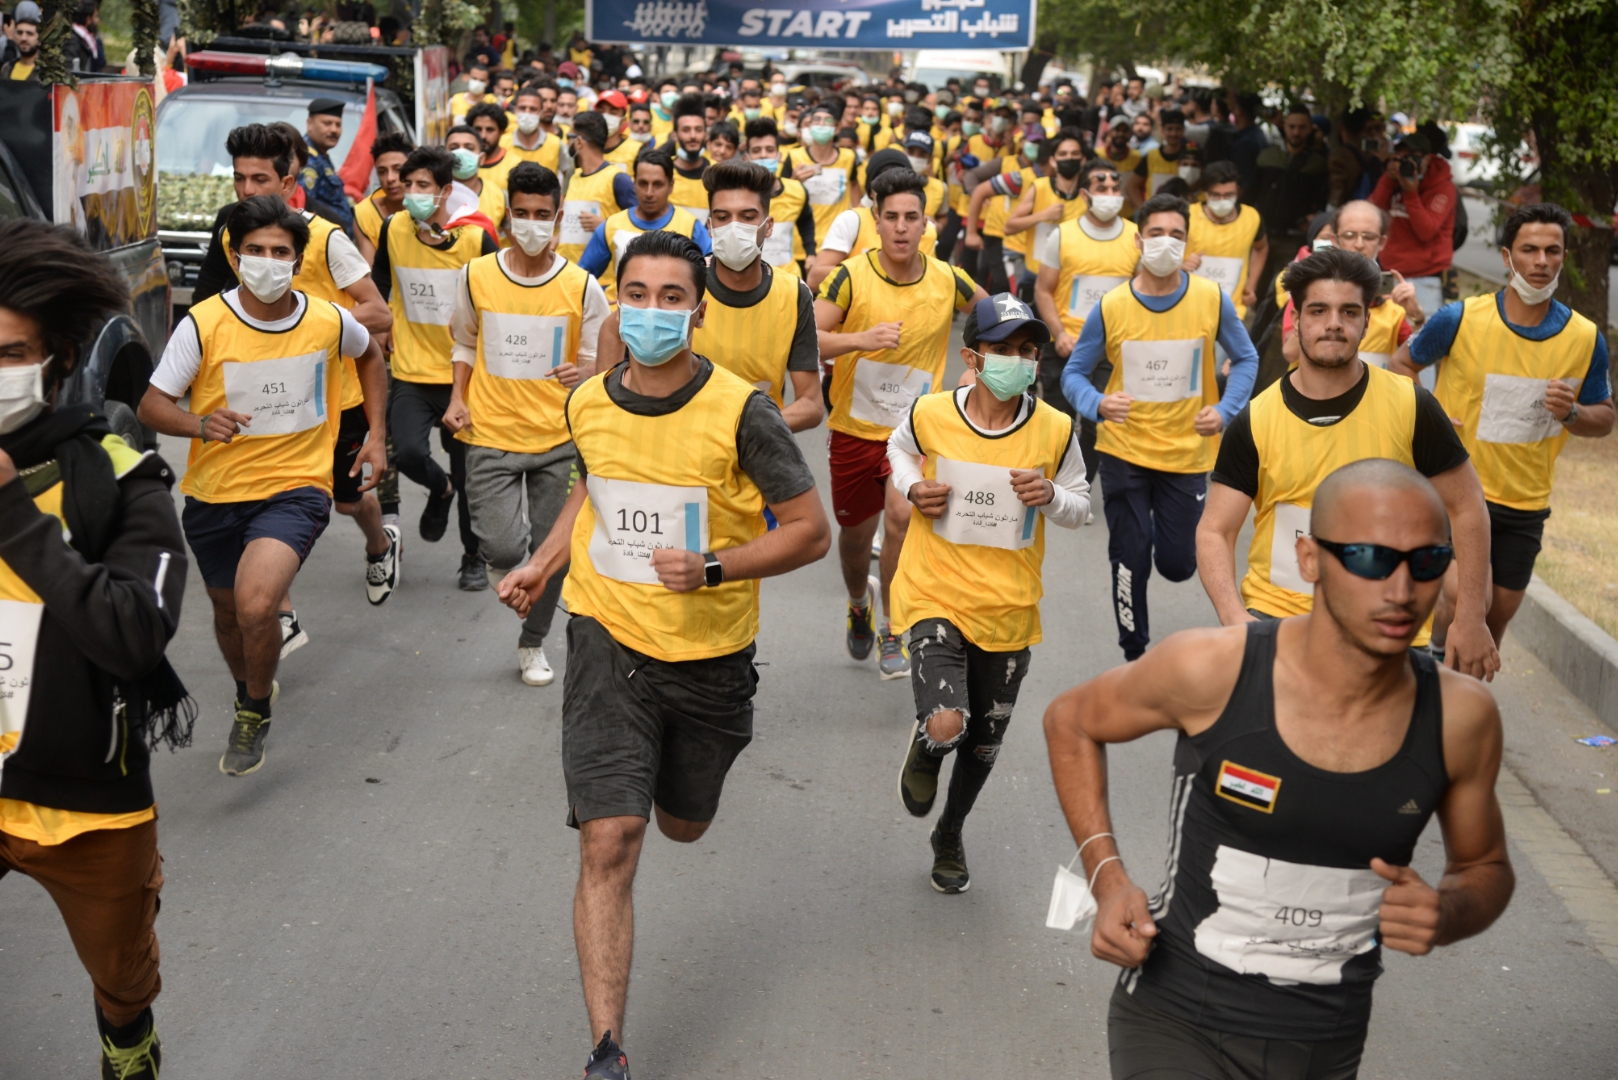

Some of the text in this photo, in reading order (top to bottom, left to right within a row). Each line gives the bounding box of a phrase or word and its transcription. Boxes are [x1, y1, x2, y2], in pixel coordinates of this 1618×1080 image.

[738, 9, 872, 38] START
[886, 10, 1019, 39] شباب التحرير
[410, 283, 436, 297] 521
[505, 334, 528, 345] 428
[1145, 360, 1168, 371] 467
[262, 382, 287, 395] 451
[880, 382, 900, 393] 430
[964, 490, 995, 506] 488
[617, 508, 663, 535] 101
[627, 540, 645, 549] شباب
[1275, 906, 1323, 927] 409
